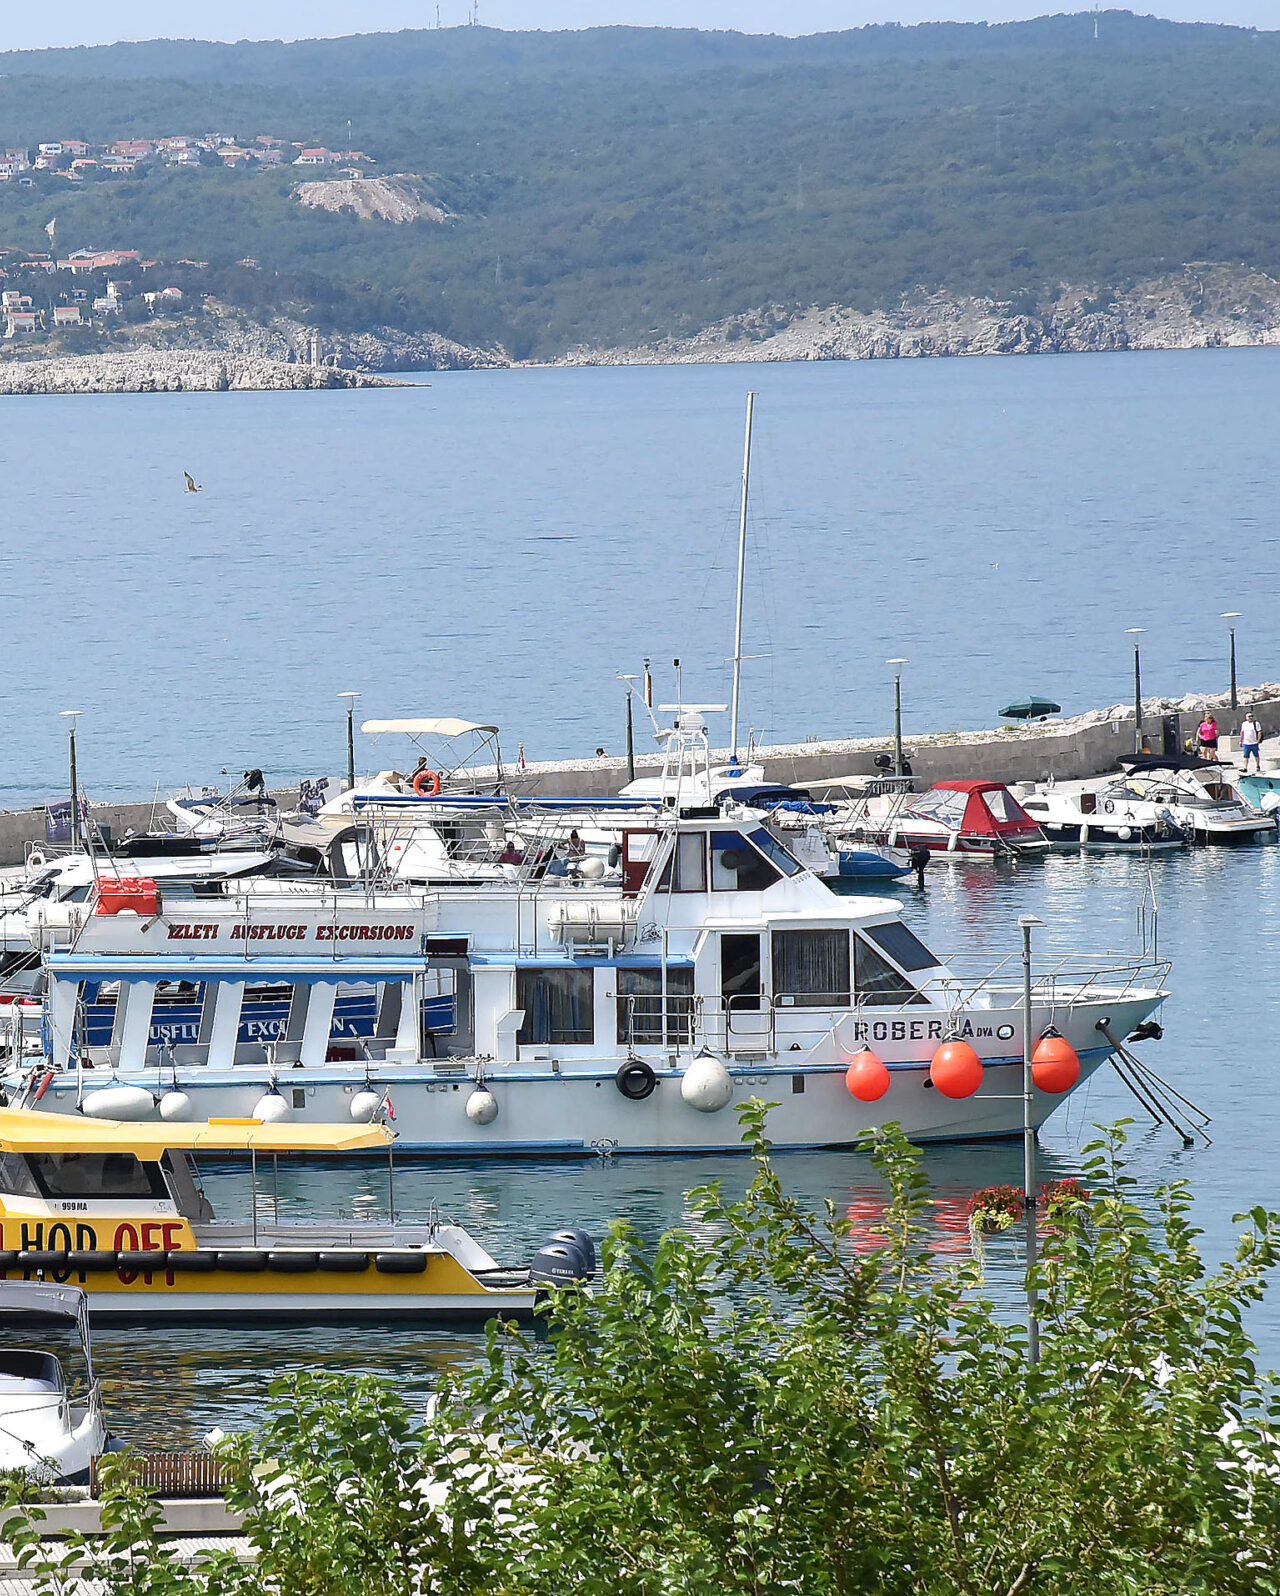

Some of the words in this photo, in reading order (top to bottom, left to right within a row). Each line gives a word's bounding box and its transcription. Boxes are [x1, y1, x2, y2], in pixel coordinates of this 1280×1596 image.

[167, 924, 219, 940] IZLETI
[229, 924, 308, 940] AUSFLUGE
[315, 925, 415, 940] EXCURSIONS
[853, 1019, 974, 1041] ROBERA
[976, 1026, 993, 1038] DVA
[20, 1221, 98, 1284] HOP
[113, 1222, 185, 1286] OFF
